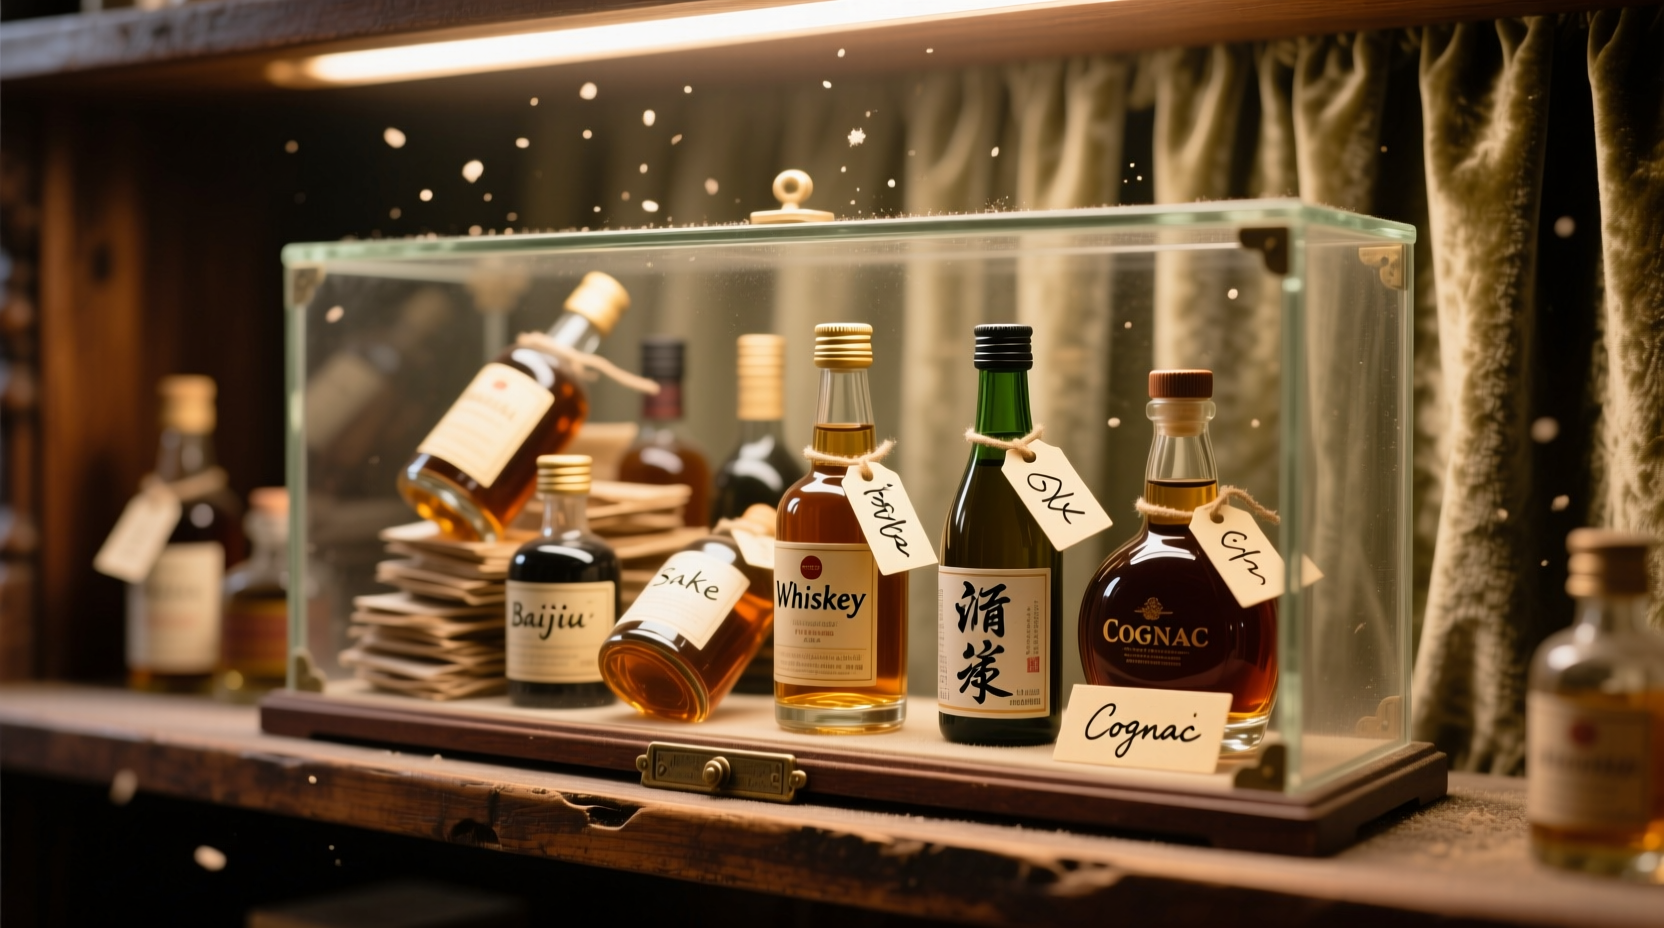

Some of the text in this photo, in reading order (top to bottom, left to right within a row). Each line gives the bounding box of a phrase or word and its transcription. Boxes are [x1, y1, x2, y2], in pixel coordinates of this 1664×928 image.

[652, 567, 719, 601] Sake
[776, 580, 867, 619] Whiskey
[511, 601, 586, 641] Baijiu
[1102, 618, 1209, 648] COGNAC
